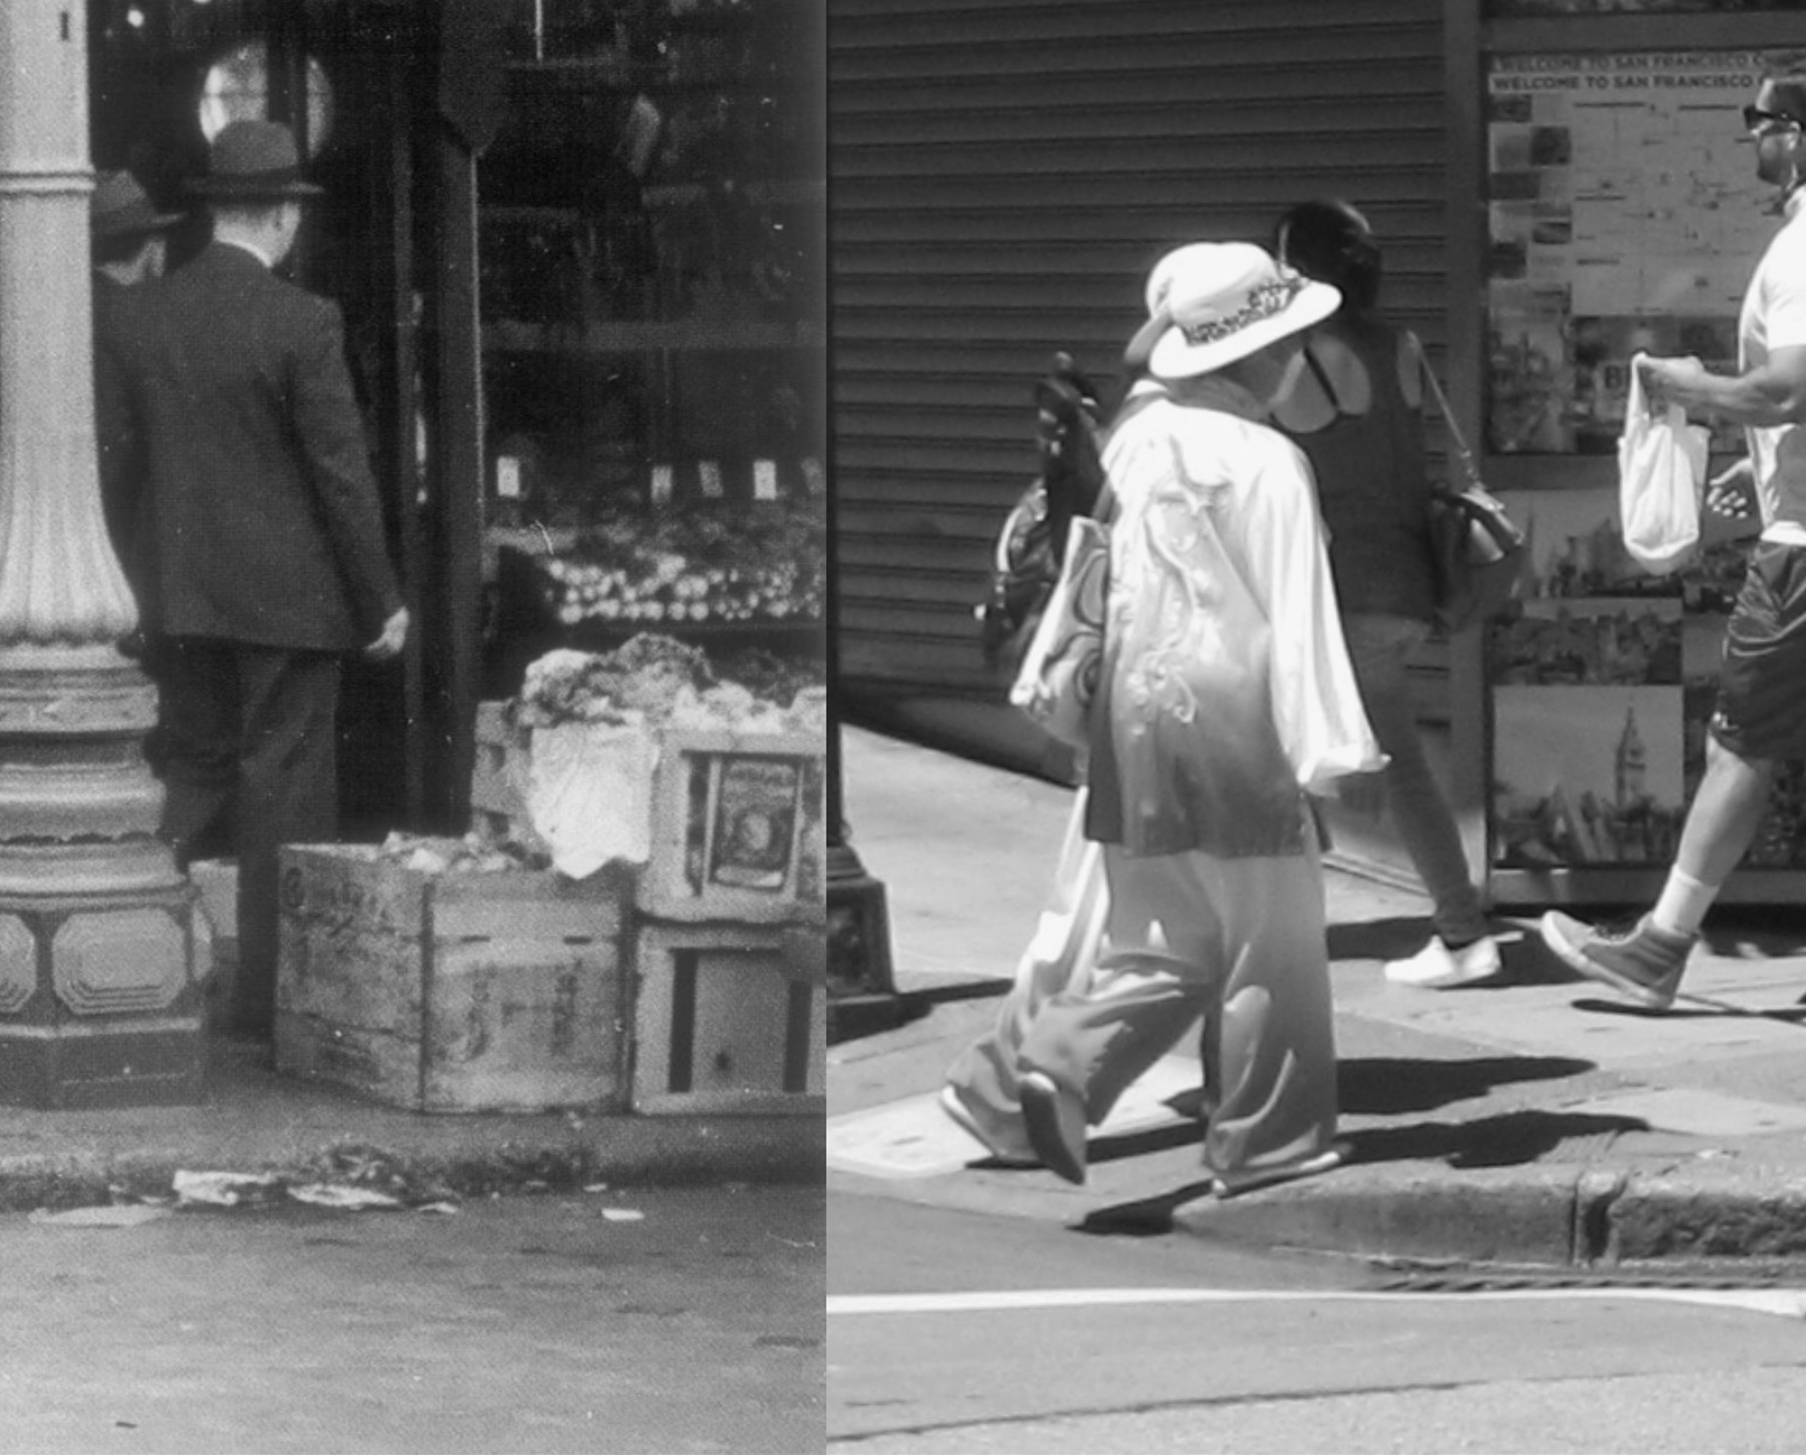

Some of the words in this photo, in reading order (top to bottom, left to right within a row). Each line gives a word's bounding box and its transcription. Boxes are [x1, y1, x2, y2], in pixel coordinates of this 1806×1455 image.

[1493, 75, 1580, 91] WELCOME
[1585, 75, 1610, 89] TO
[1614, 75, 1650, 89] SAN
[1653, 74, 1754, 89] FRANCISCO
